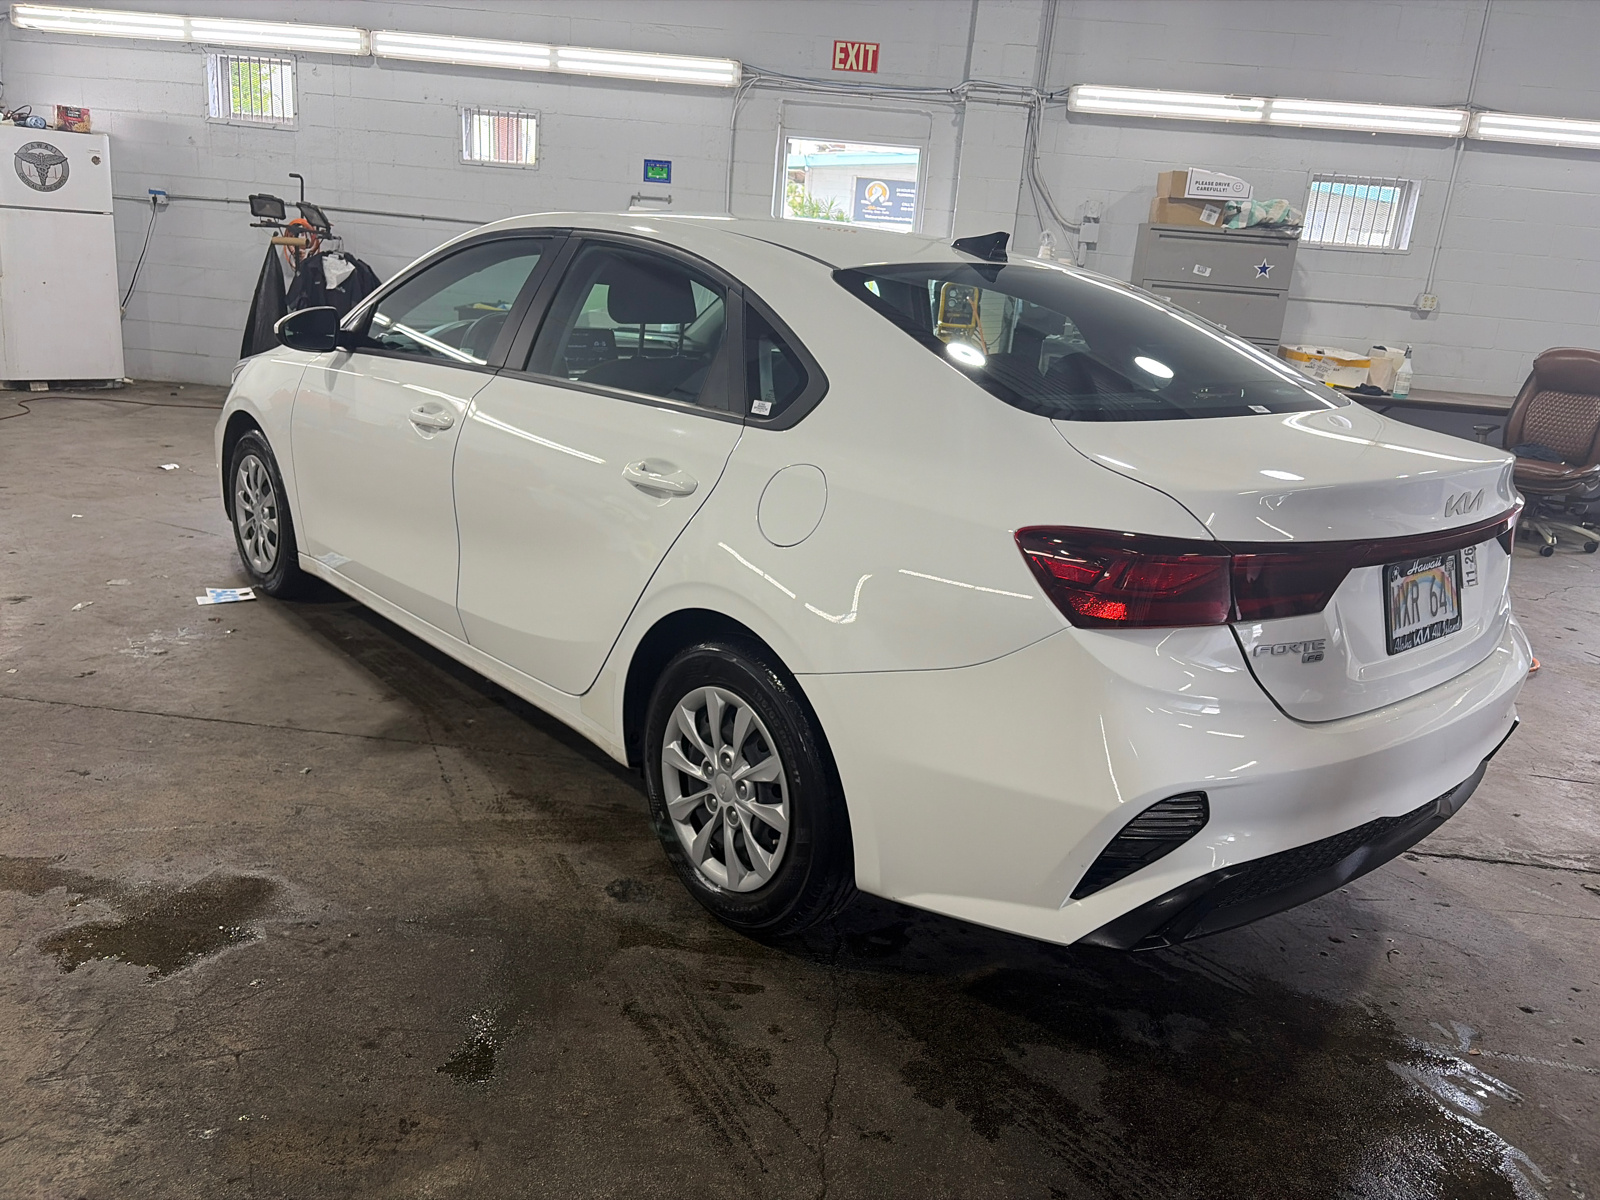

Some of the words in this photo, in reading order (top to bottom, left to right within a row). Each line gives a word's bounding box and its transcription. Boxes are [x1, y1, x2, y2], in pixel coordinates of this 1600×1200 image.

[834, 42, 877, 71] EXIT
[24, 143, 57, 154] HAWAII
[1445, 488, 1485, 517] KIA
[1407, 556, 1442, 575] Hawaii
[1464, 547, 1475, 587] 11-26
[1253, 639, 1326, 657] FORTE
